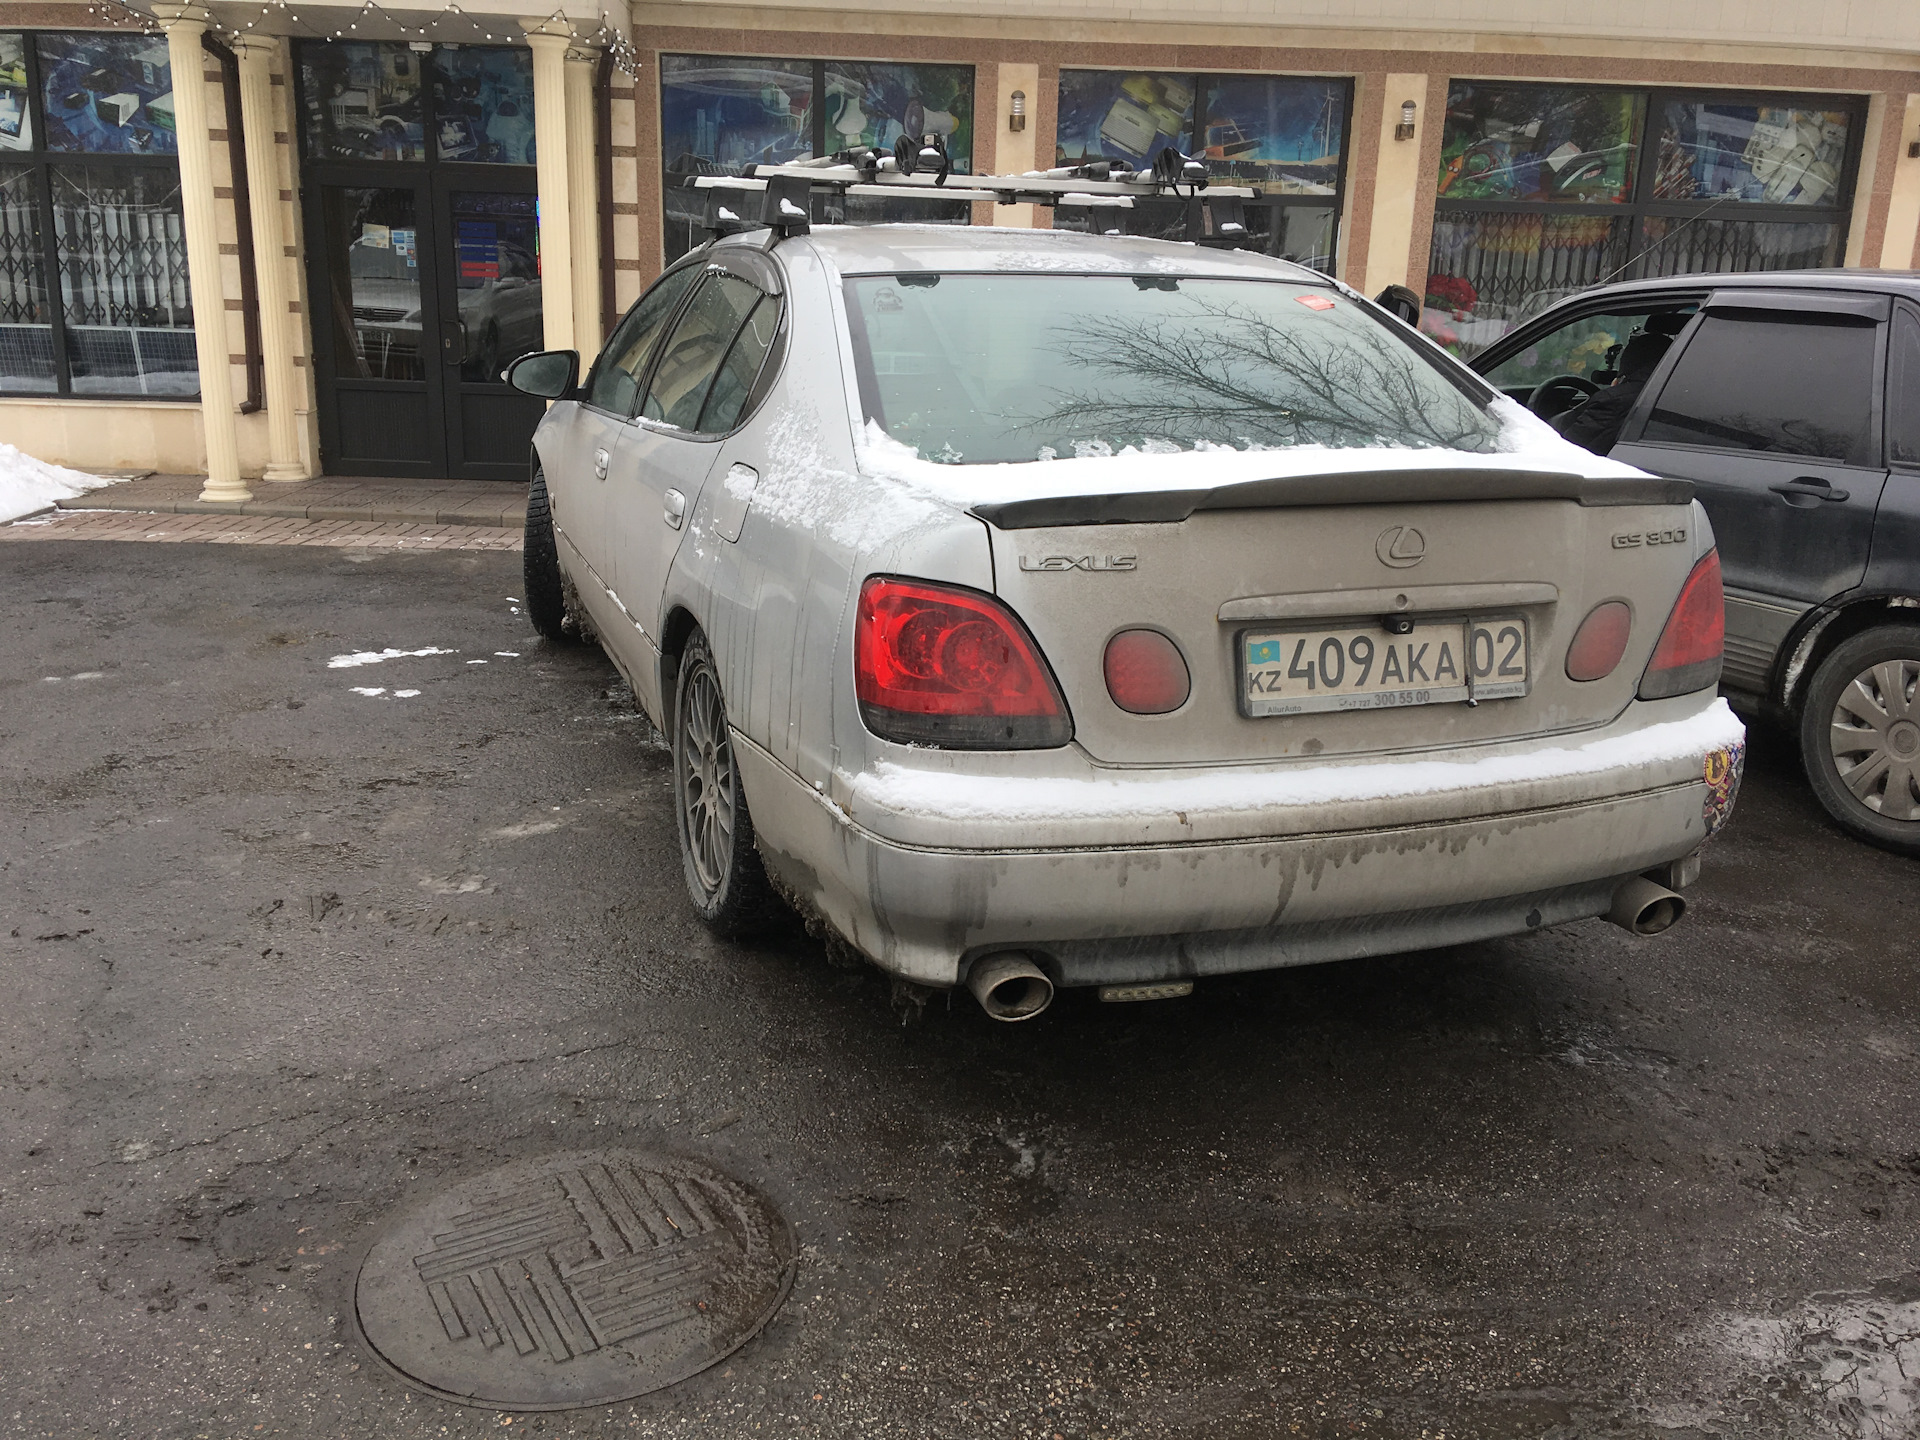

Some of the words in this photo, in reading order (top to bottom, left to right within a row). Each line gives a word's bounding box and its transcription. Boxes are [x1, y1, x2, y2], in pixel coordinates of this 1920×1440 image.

[1612, 533, 1641, 549] GS
[1646, 528, 1687, 545] 300
[1018, 555, 1137, 571] LEXUS
[1472, 626, 1523, 678] 02
[1248, 670, 1282, 694] KZ
[1358, 698, 1371, 707] 727
[1374, 693, 1396, 706] 300
[1400, 691, 1415, 704] 55
[1416, 690, 1430, 703] 00
[1267, 704, 1302, 714] AllurAuto
